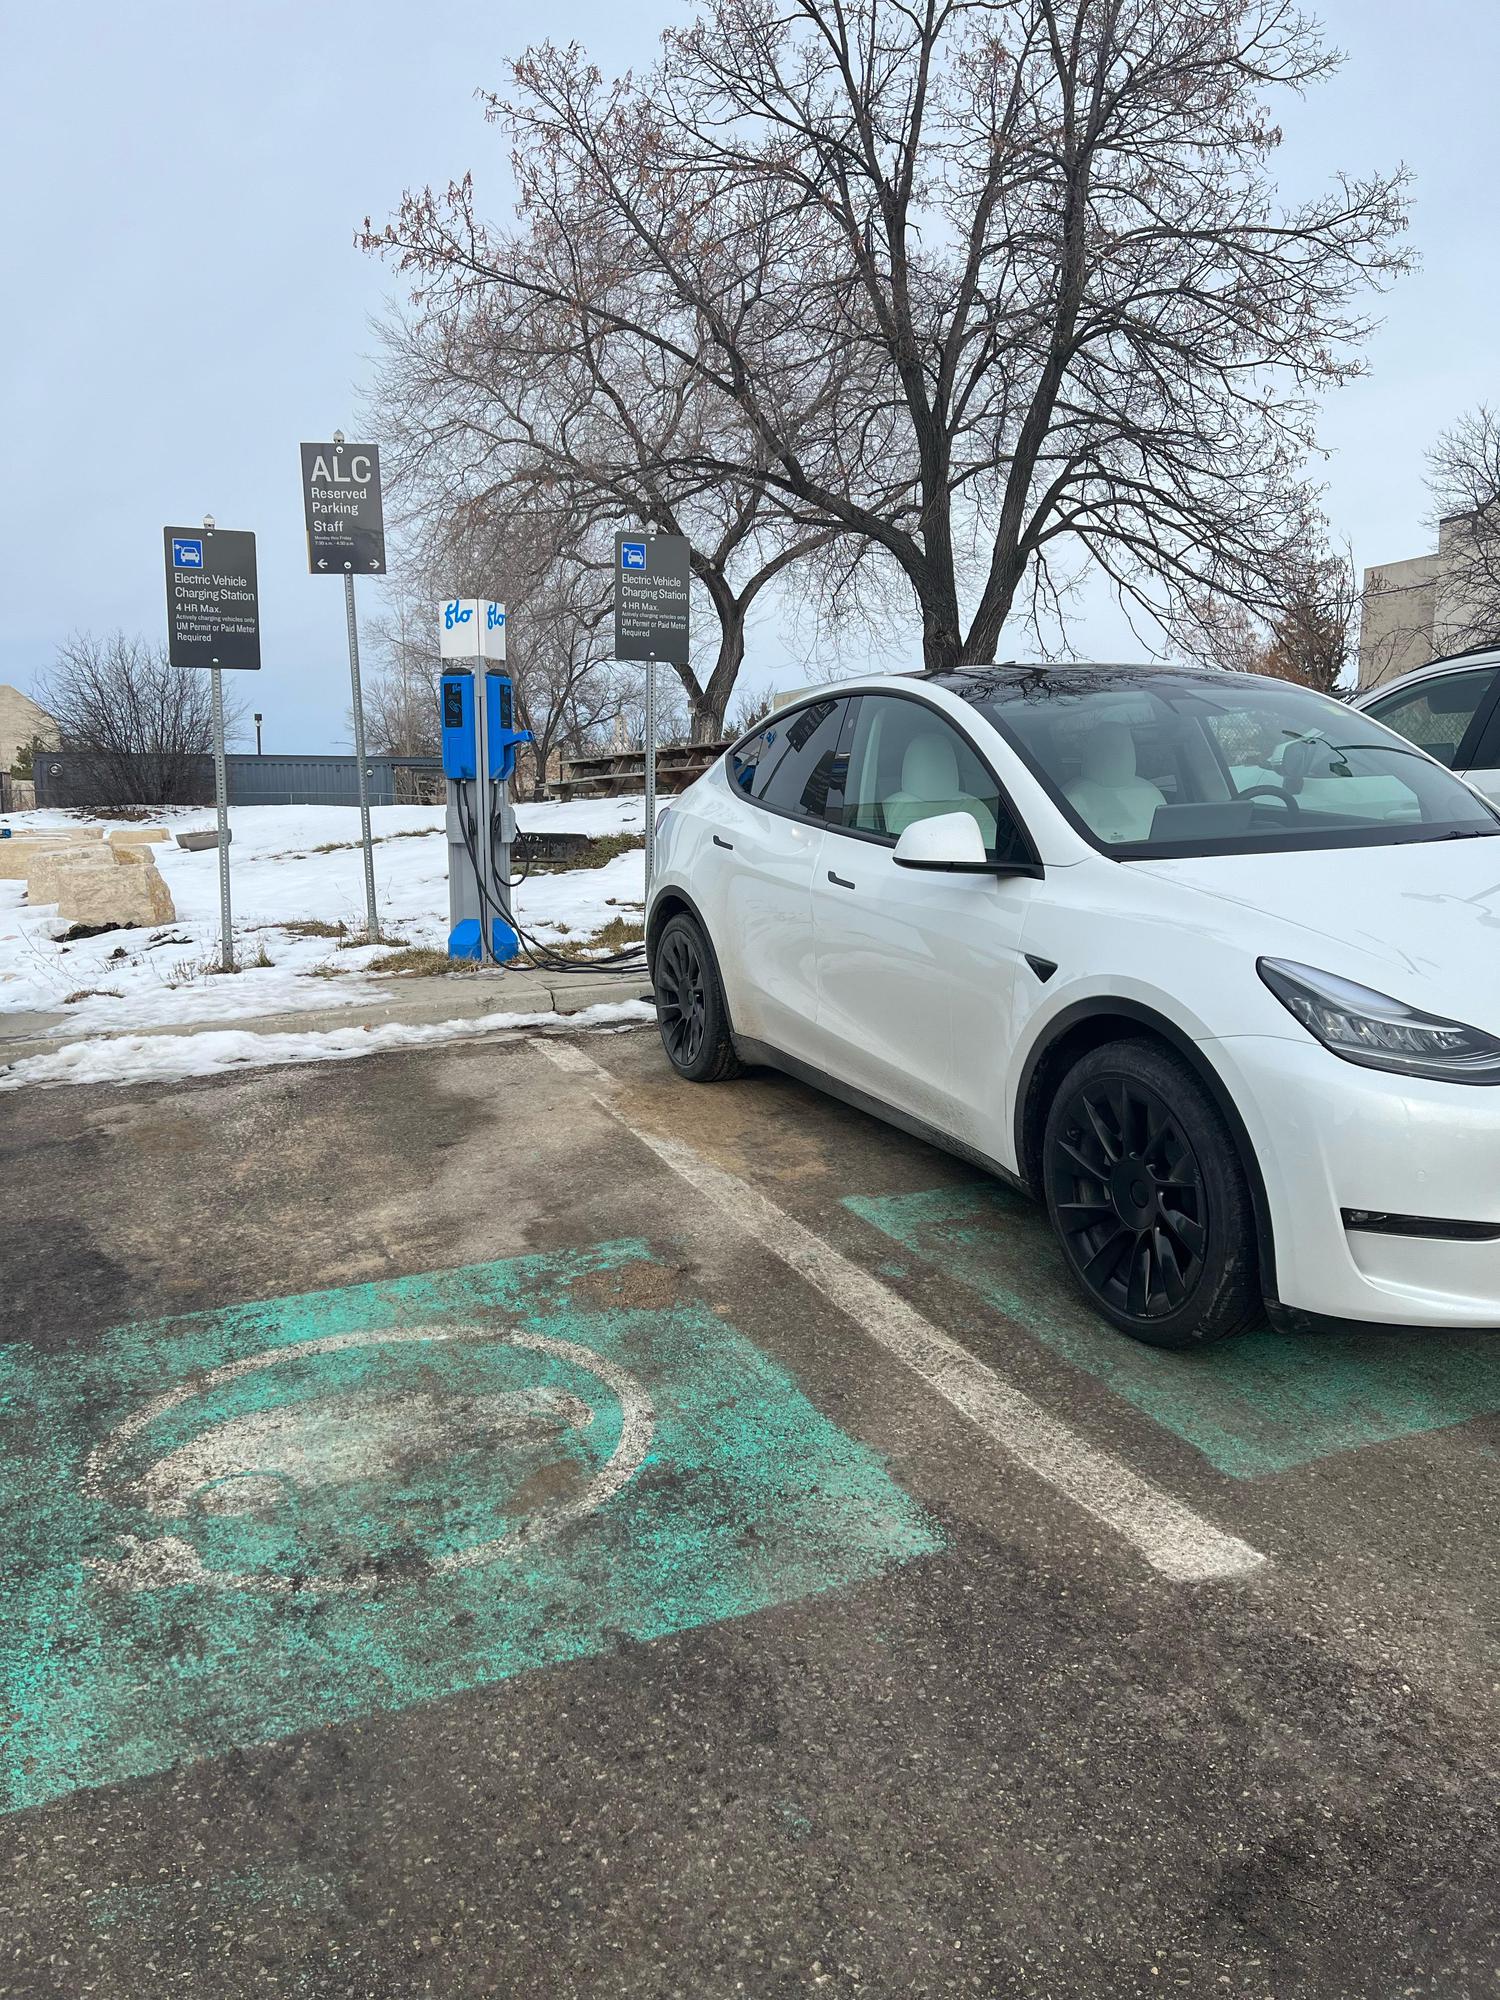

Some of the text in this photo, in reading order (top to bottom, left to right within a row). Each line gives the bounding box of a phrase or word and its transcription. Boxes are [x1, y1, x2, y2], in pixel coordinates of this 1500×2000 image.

[311, 456, 371, 483] ALC
[312, 488, 367, 499] Reserved
[313, 502, 358, 515] Parking
[314, 521, 343, 532] Staff
[175, 573, 247, 586] Electric Vehicle
[622, 574, 681, 587] Electric Vehicle
[175, 587, 254, 601] Charging Station
[622, 587, 686, 600] Charging Station
[445, 598, 472, 629] flo
[487, 602, 505, 630] flo
[190, 623, 210, 631] Permit
[221, 624, 235, 632] Paid
[622, 628, 650, 637] Required
[178, 633, 211, 642] Required
